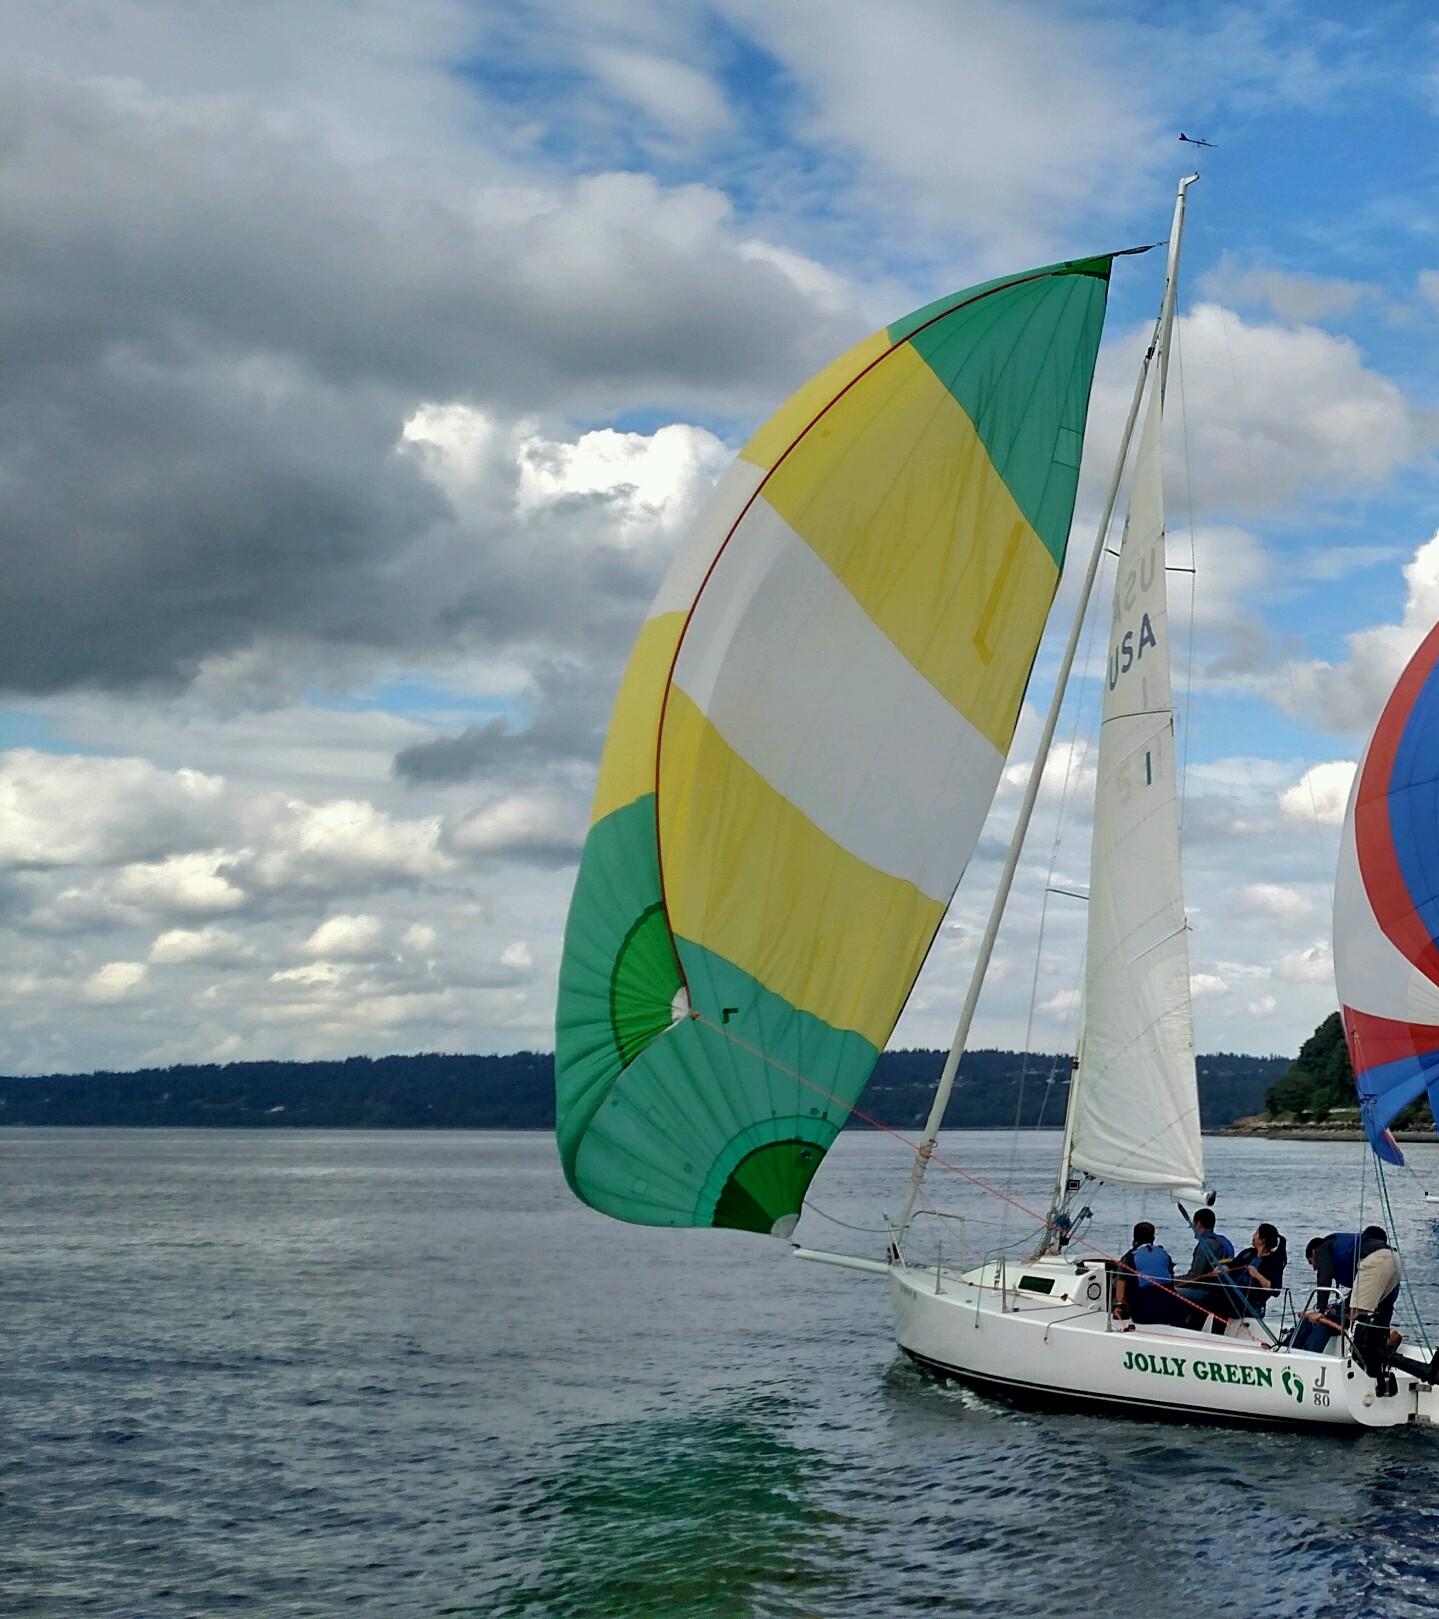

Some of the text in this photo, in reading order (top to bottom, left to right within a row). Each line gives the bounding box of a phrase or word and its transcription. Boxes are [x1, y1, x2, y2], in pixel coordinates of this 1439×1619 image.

[1108, 612, 1157, 692] USA
[1123, 1351, 1273, 1388] JOLLY GREEN
[1314, 1366, 1327, 1388] J
[1313, 1393, 1331, 1408] 80
